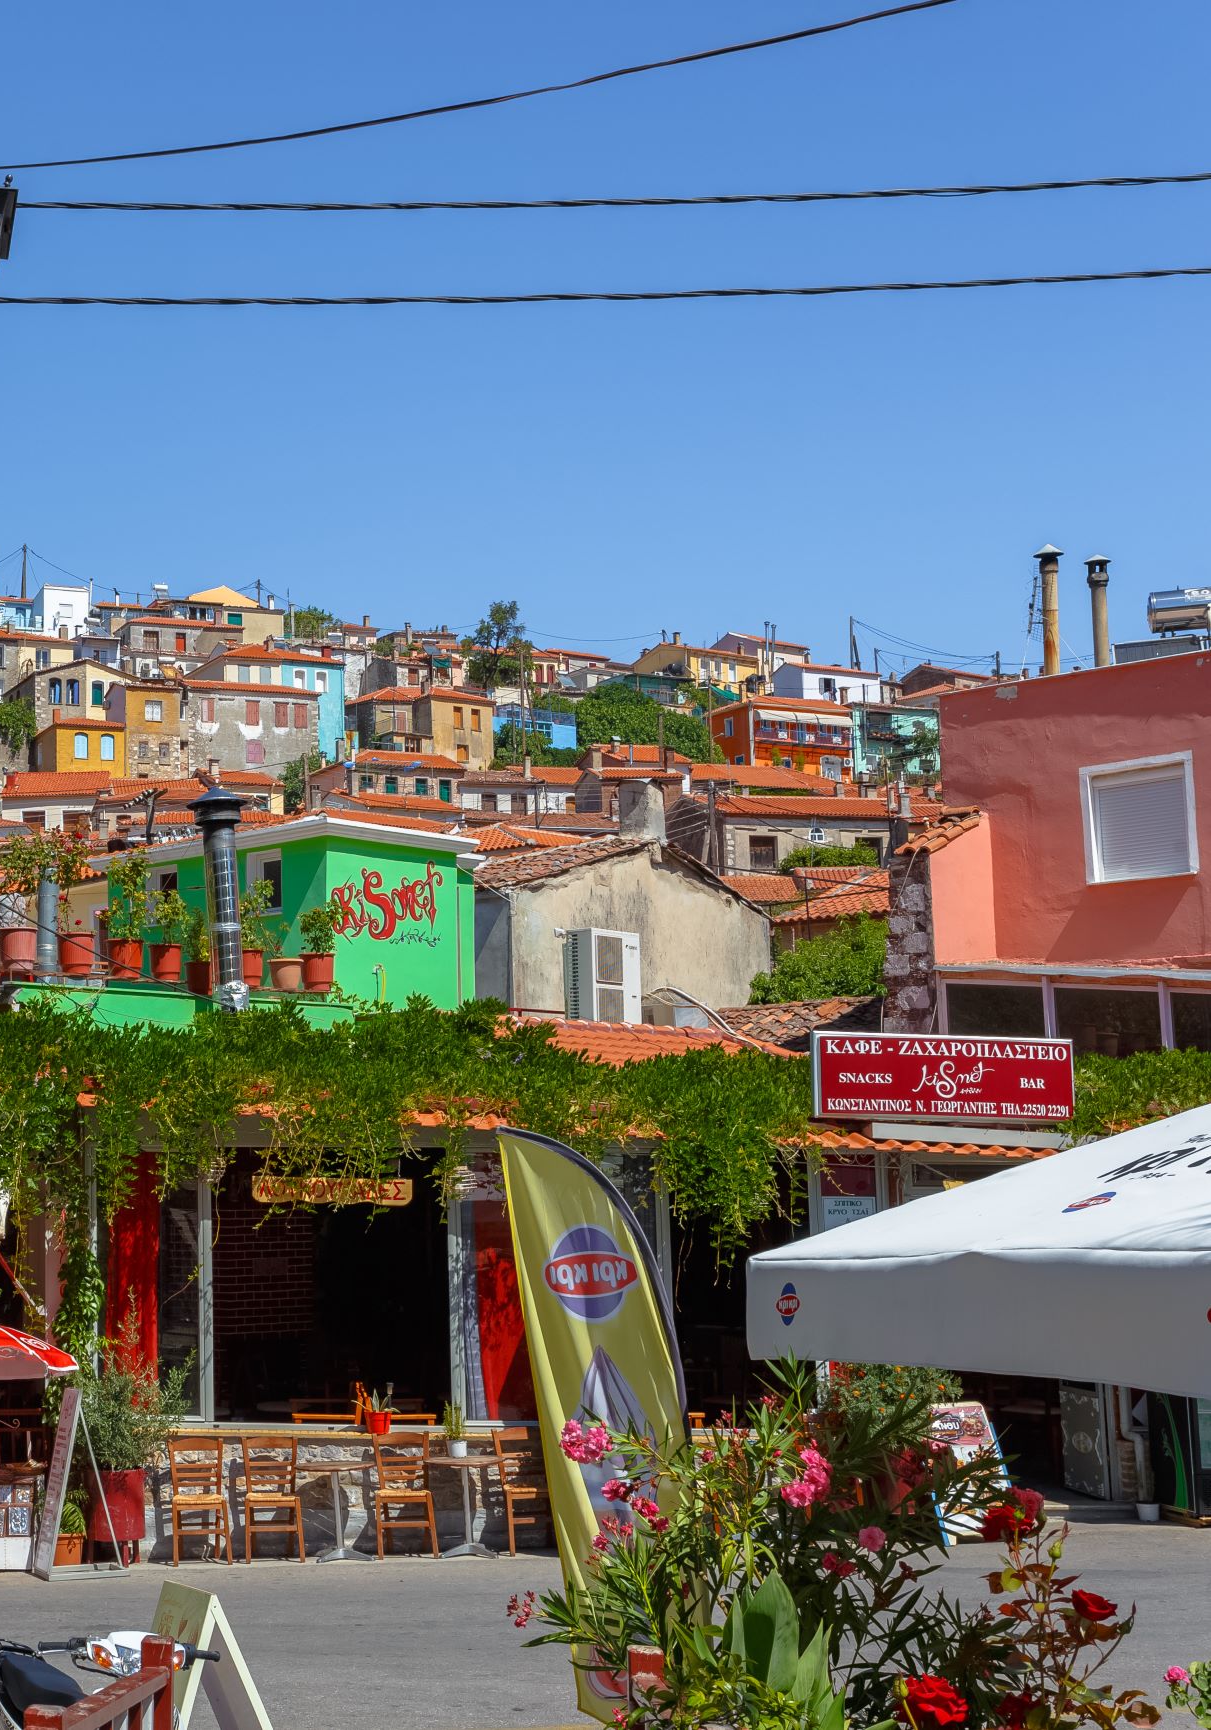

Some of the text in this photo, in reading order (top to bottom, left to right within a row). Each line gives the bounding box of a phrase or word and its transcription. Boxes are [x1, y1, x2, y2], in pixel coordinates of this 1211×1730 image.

[825, 1039, 883, 1055] ΚΑΦΕ
[898, 1040, 1067, 1061] ΖΑΧΑΡΟΠΛΑΣΤΕΙΟ
[838, 1072, 893, 1084] SNACKS
[1019, 1077, 1046, 1089] BAR
[827, 1098, 912, 1112] ΚΩΝΣΤΑΝΤΙΝΟΣ
[915, 1099, 927, 1112] Ν.
[930, 1100, 997, 1115] ΓΕΩΡΓΑΝΤΗΣ
[1047, 1104, 1070, 1118] 22291
